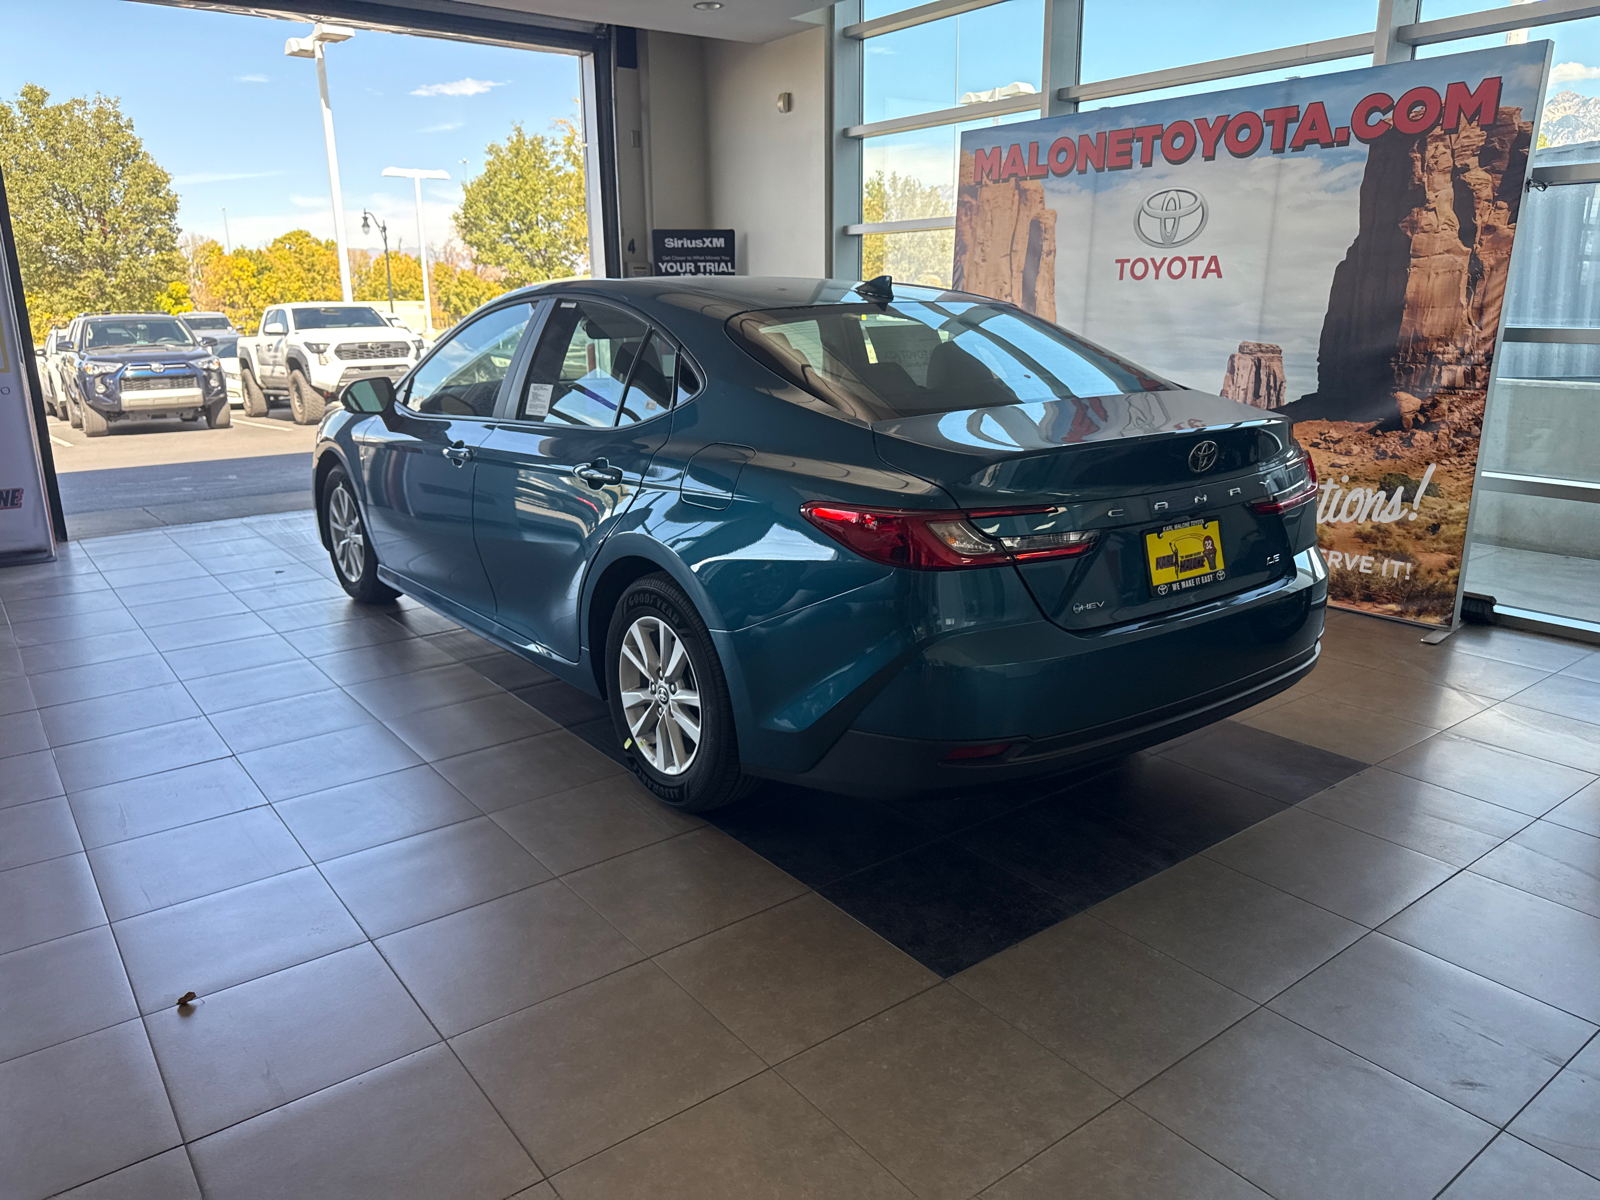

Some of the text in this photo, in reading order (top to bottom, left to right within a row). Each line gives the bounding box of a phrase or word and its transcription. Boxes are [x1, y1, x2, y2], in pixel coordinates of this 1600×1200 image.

[973, 76, 1503, 186] MALONETOYOTA.COM
[664, 237, 725, 249] SiriusXM
[658, 262, 735, 273] YOUR TRIAL
[1115, 255, 1223, 281] TOYOTA
[1107, 479, 1270, 518] CAMRY
[1162, 518, 1205, 532] KARL MALONE TOYOTA
[1204, 540, 1213, 550] 32
[1266, 553, 1280, 566] LE
[1381, 559, 1412, 581] IT!
[1172, 583, 1181, 592] WE
[1181, 579, 1196, 590] MAKE
[1195, 577, 1201, 586] IT
[628, 593, 680, 626] GOODYEAR
